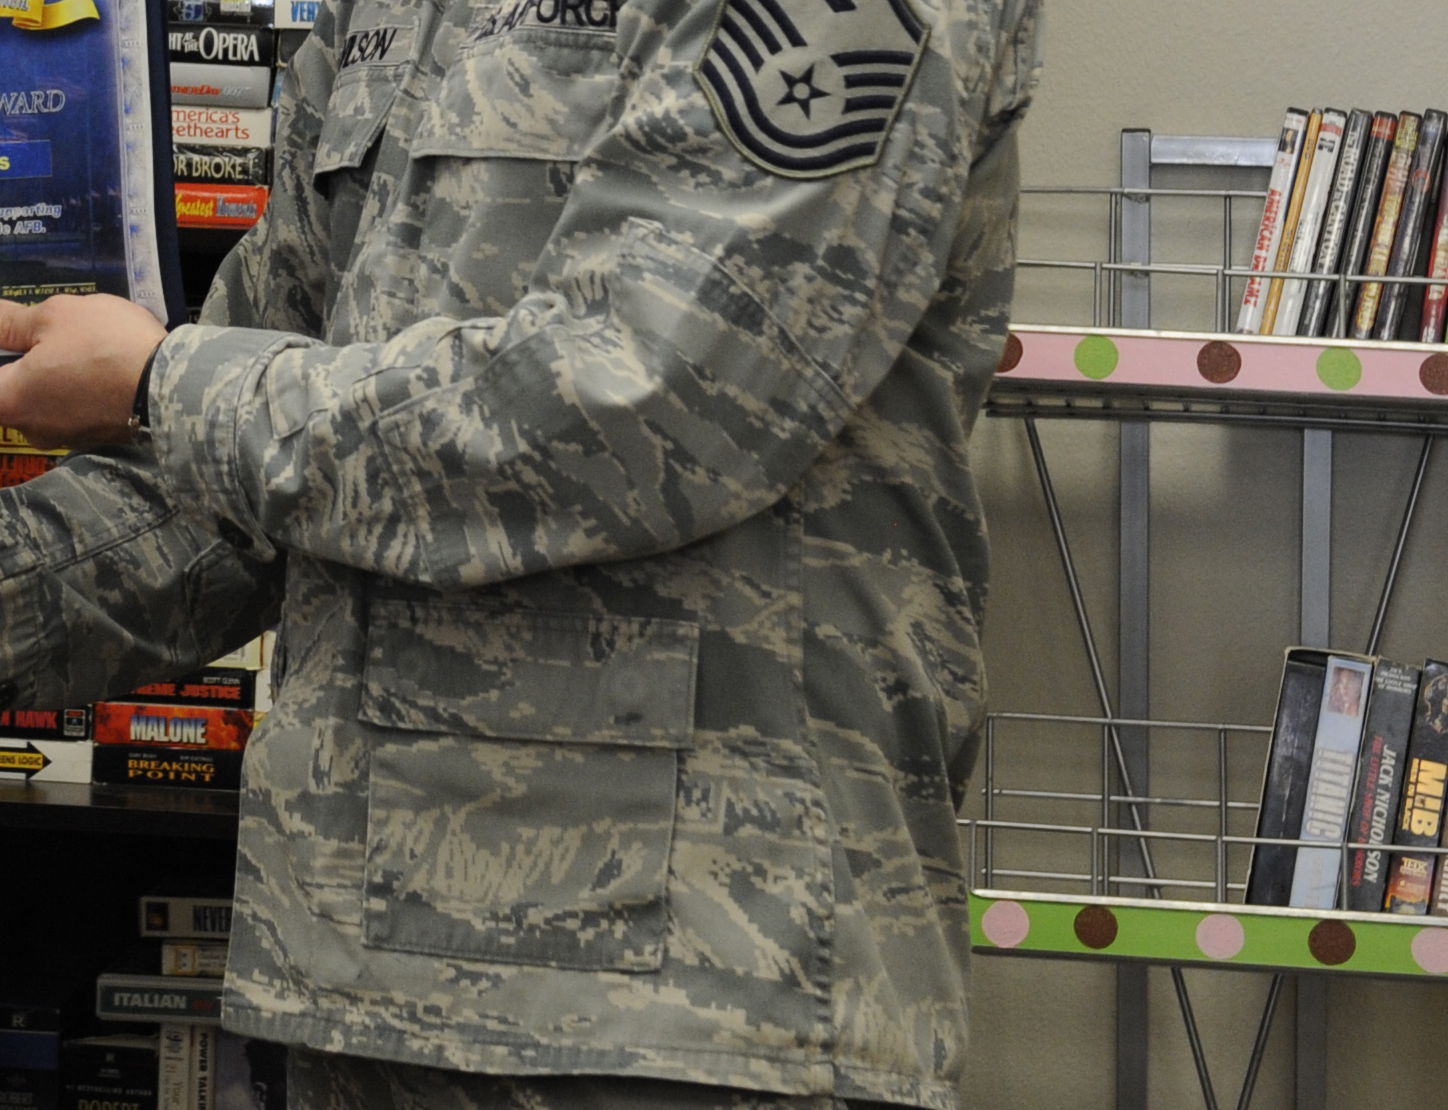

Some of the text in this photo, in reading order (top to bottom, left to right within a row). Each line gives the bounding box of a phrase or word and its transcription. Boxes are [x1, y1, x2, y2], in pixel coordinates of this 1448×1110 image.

[200, 27, 260, 62] OPERA
[171, 107, 241, 125] merica's
[13, 220, 47, 235] AFB.
[1255, 188, 1282, 252] AMERICAN
[179, 684, 241, 700] JUSTICE
[15, 709, 59, 729] HAWK
[130, 714, 208, 744] MALONE
[128, 758, 215, 774] BREAKING
[1376, 744, 1397, 788] JACK
[128, 770, 215, 783] POINT
[1304, 747, 1352, 840] TITANIC
[113, 992, 187, 1010] ITALIAN
